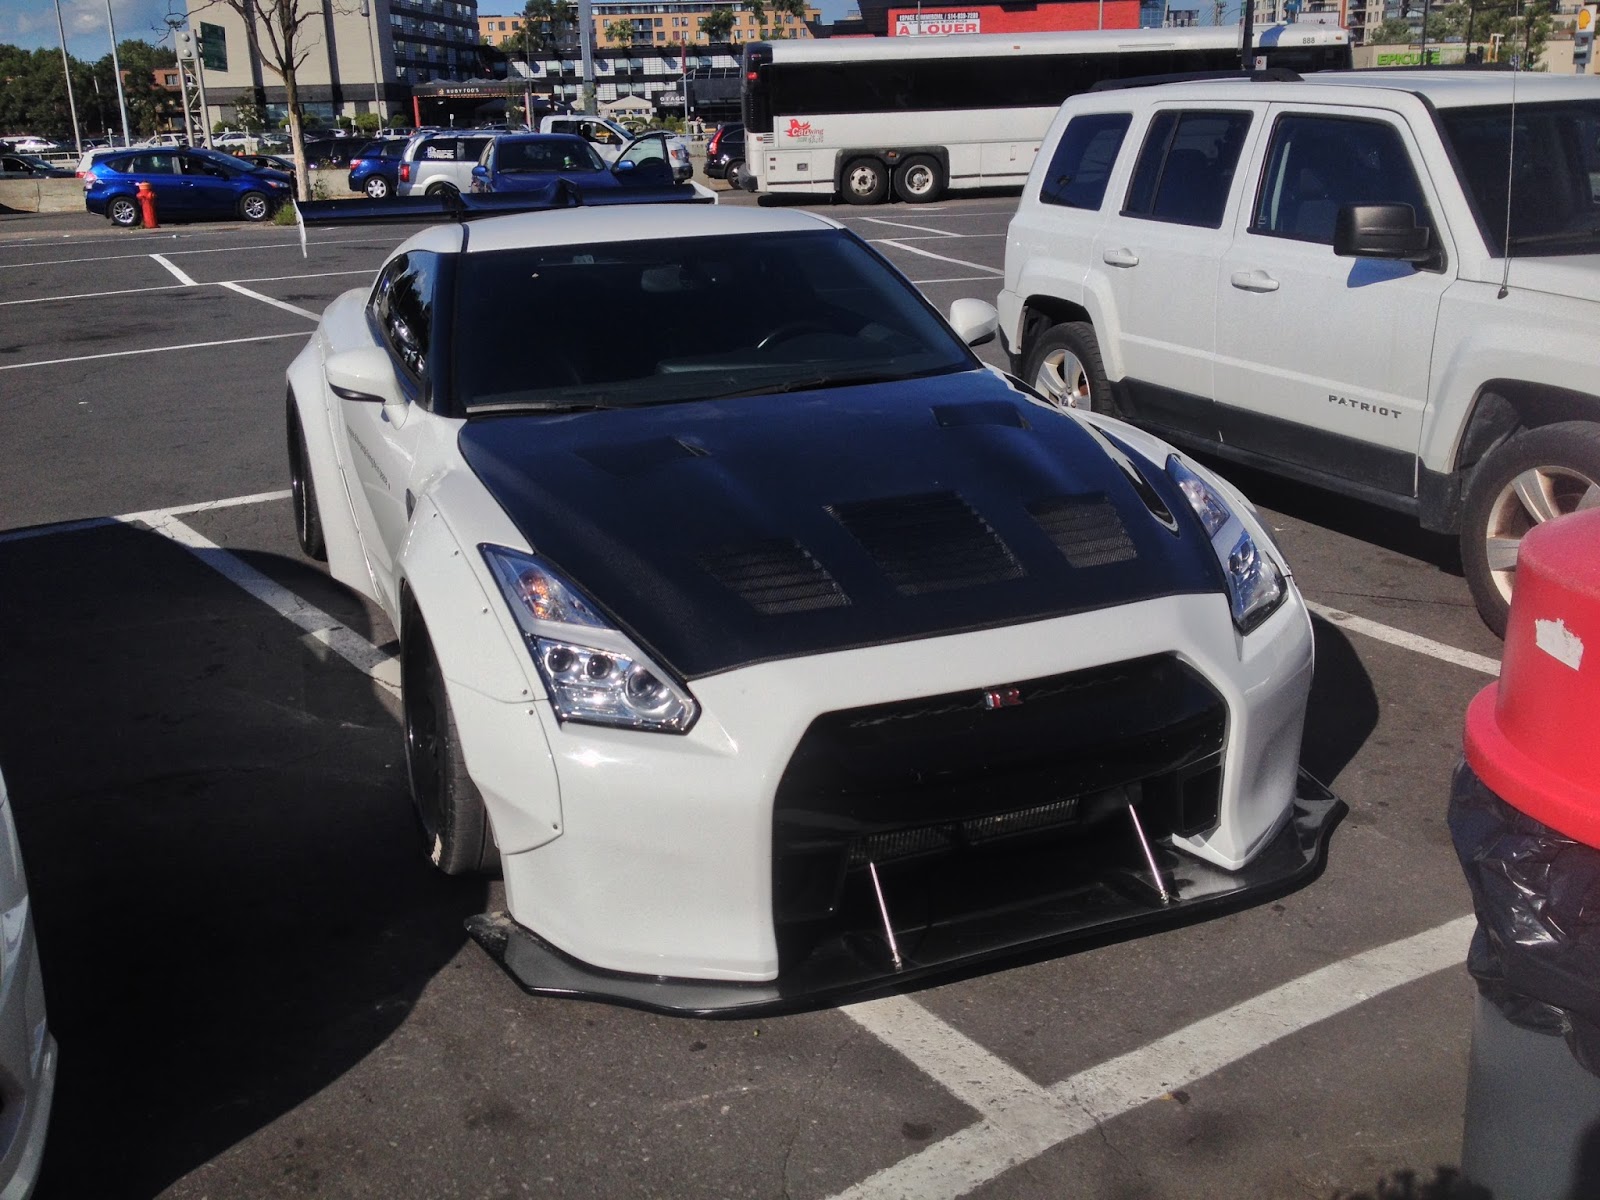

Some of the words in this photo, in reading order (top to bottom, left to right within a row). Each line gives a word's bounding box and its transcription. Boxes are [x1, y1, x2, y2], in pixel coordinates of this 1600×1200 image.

[915, 13, 944, 21] CMMERCIAL
[899, 23, 911, 35] À
[918, 23, 977, 35] LOUER
[1377, 51, 1441, 66] EPICUE
[1328, 394, 1402, 419] PATRIOT
